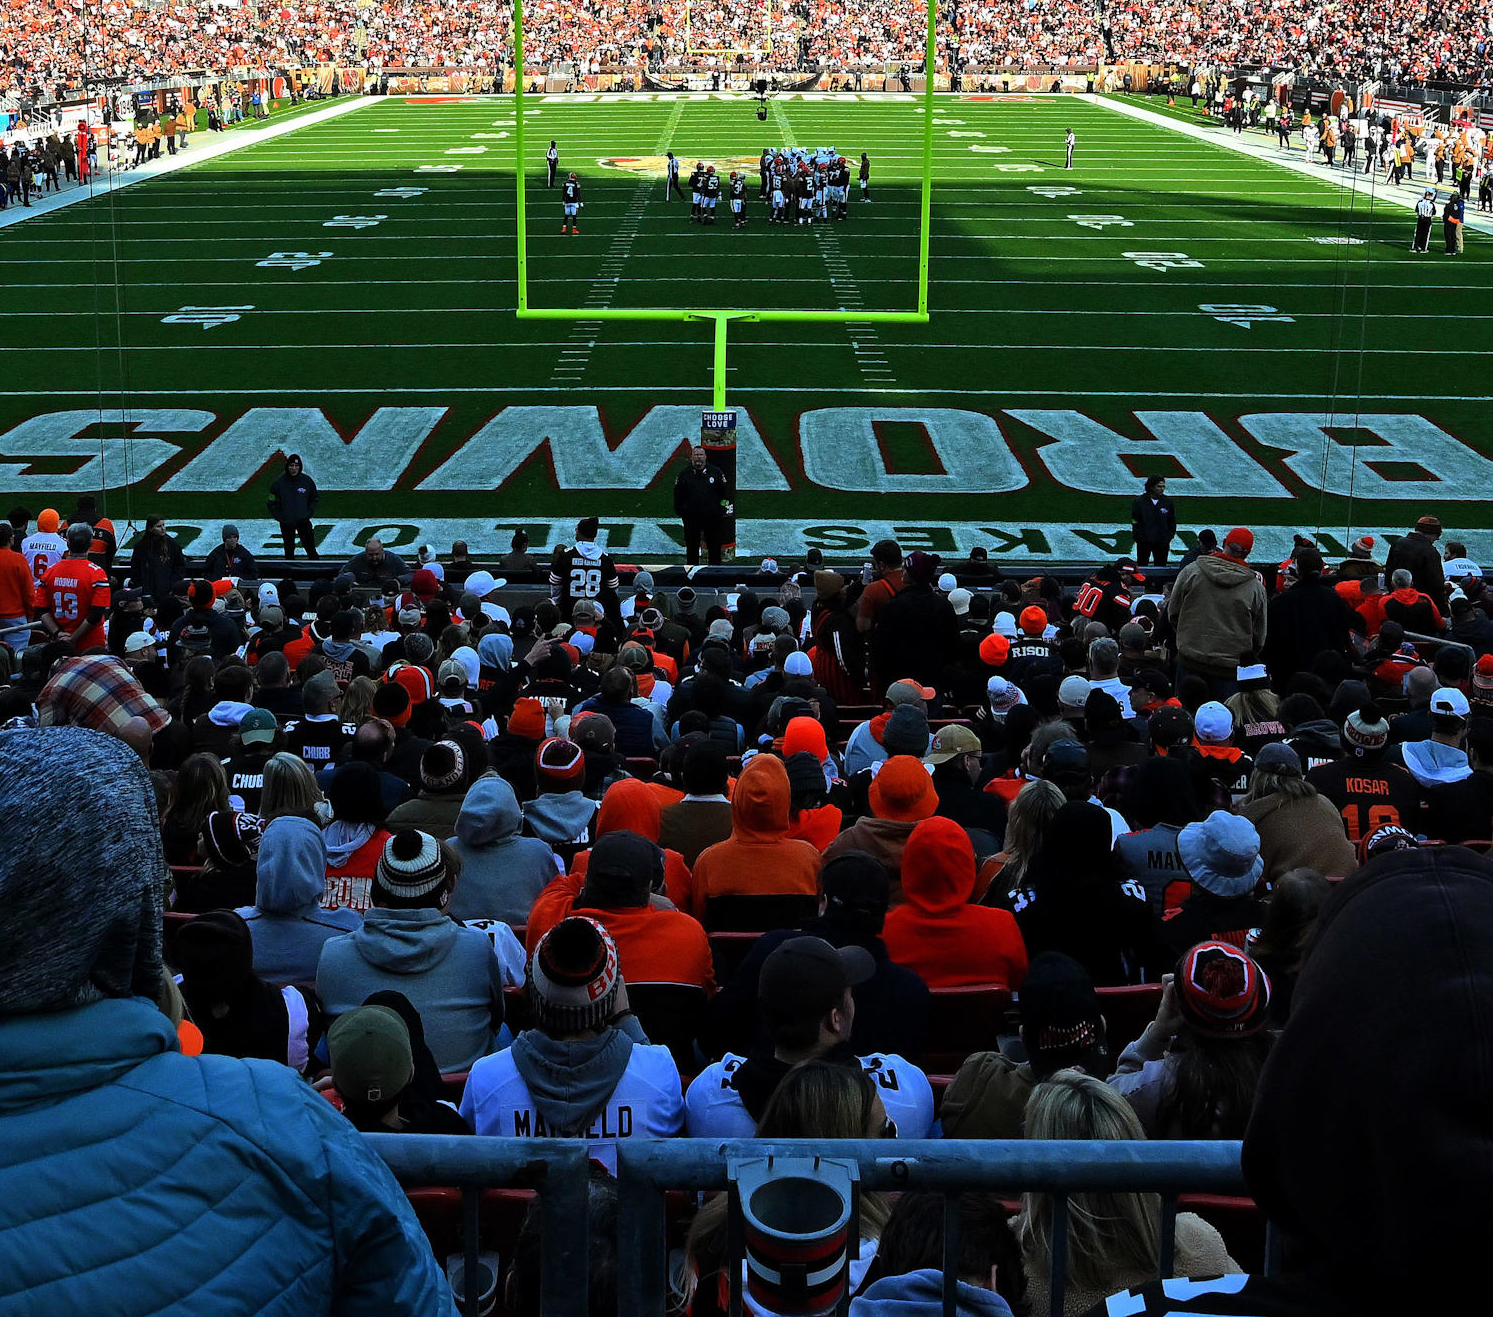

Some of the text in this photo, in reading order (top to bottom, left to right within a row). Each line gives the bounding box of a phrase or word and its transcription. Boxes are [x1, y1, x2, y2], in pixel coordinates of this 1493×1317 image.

[34, 553, 48, 579] 6
[570, 569, 602, 598] 28
[52, 591, 78, 619] 13
[232, 773, 264, 789] CHUB
[1345, 777, 1390, 796] KOSAR
